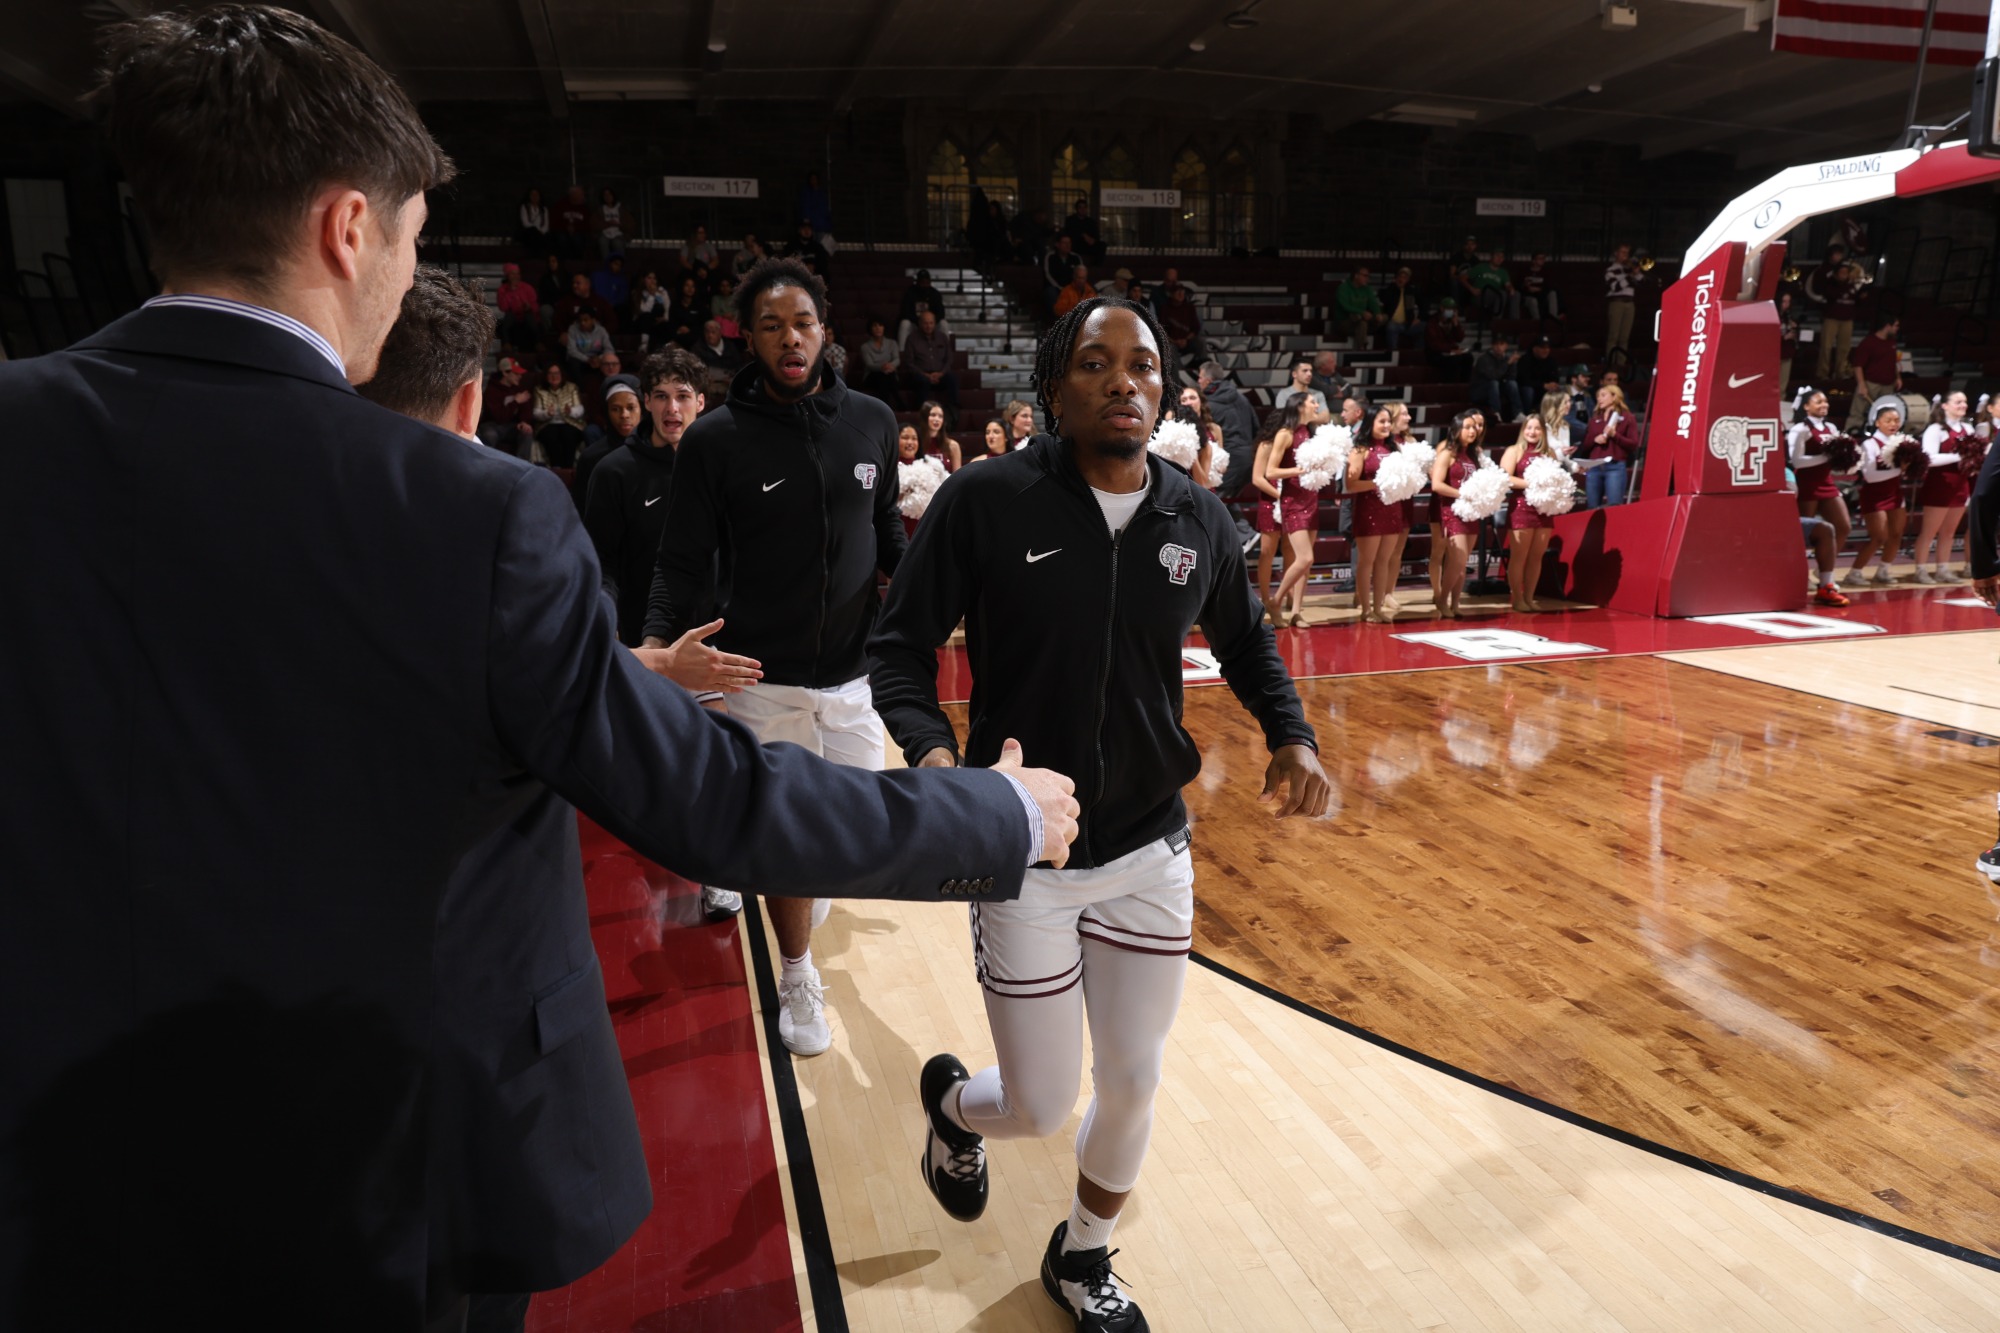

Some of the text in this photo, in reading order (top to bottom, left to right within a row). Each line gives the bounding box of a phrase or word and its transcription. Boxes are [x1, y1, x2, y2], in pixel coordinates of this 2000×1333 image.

[1818, 156, 1882, 182] SPALDING
[671, 181, 752, 195] SECTION 117
[1106, 192, 1175, 205] SECTION 118
[1481, 202, 1541, 215] SECTION 119
[1676, 269, 1715, 440] TicketSmarter
